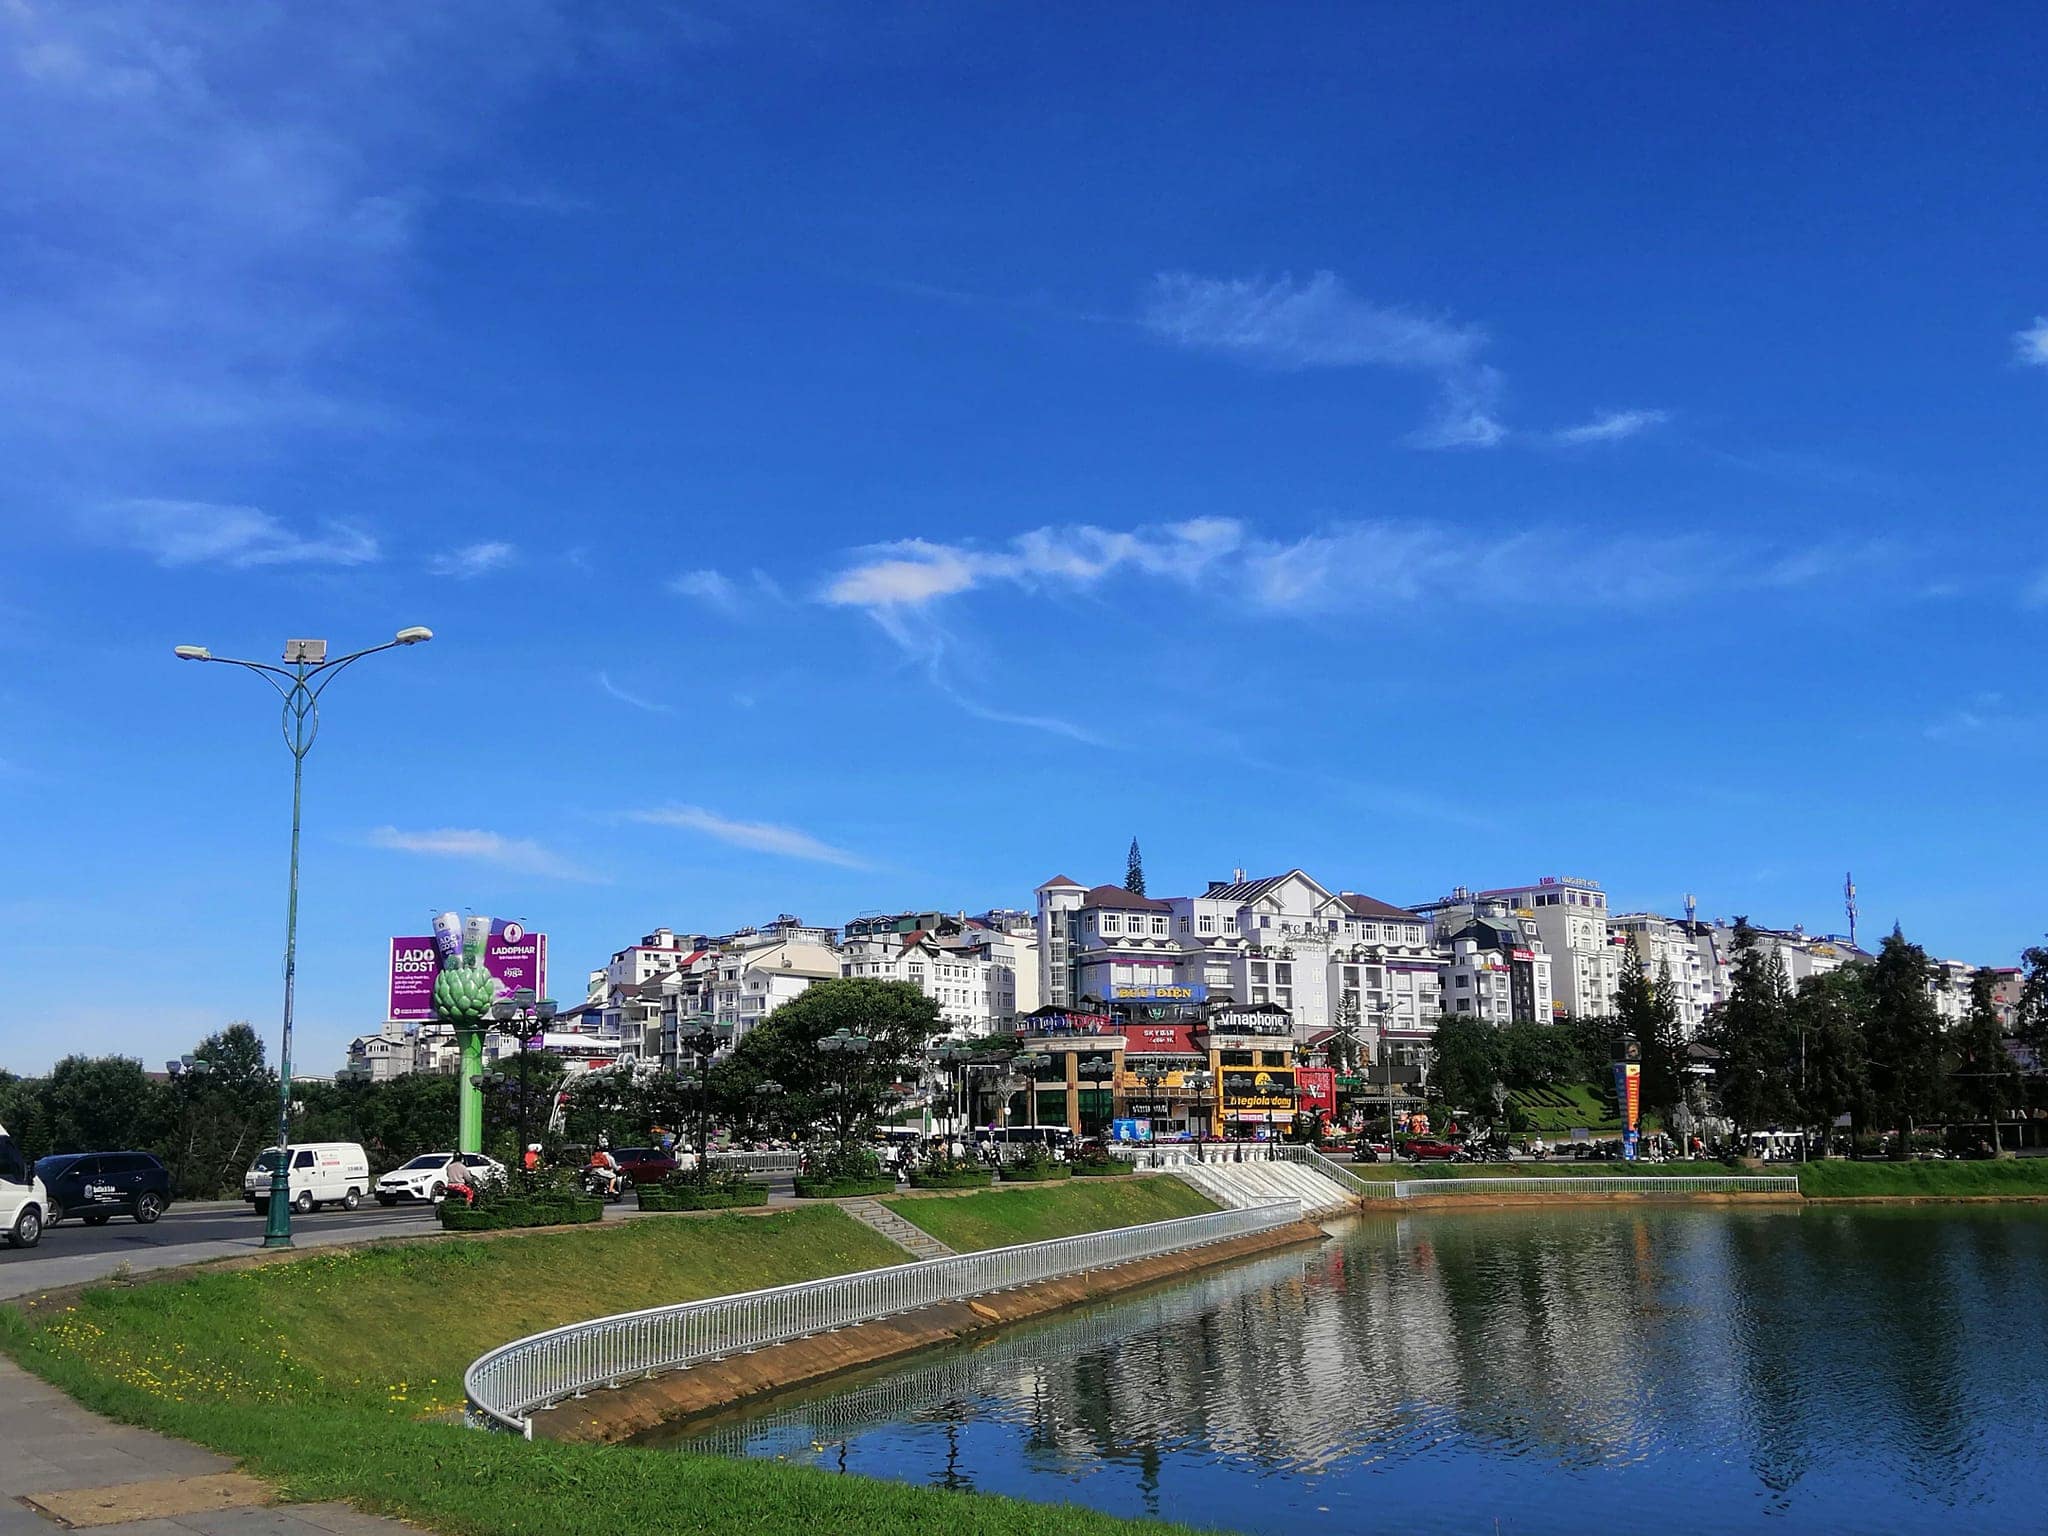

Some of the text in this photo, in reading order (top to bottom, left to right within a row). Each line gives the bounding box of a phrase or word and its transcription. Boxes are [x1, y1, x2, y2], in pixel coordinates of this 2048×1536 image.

[395, 949, 435, 962] LADO
[491, 946, 536, 955] LADOPHAR
[395, 961, 435, 972] BOOST
[1220, 1010, 1284, 1028] vinaphone
